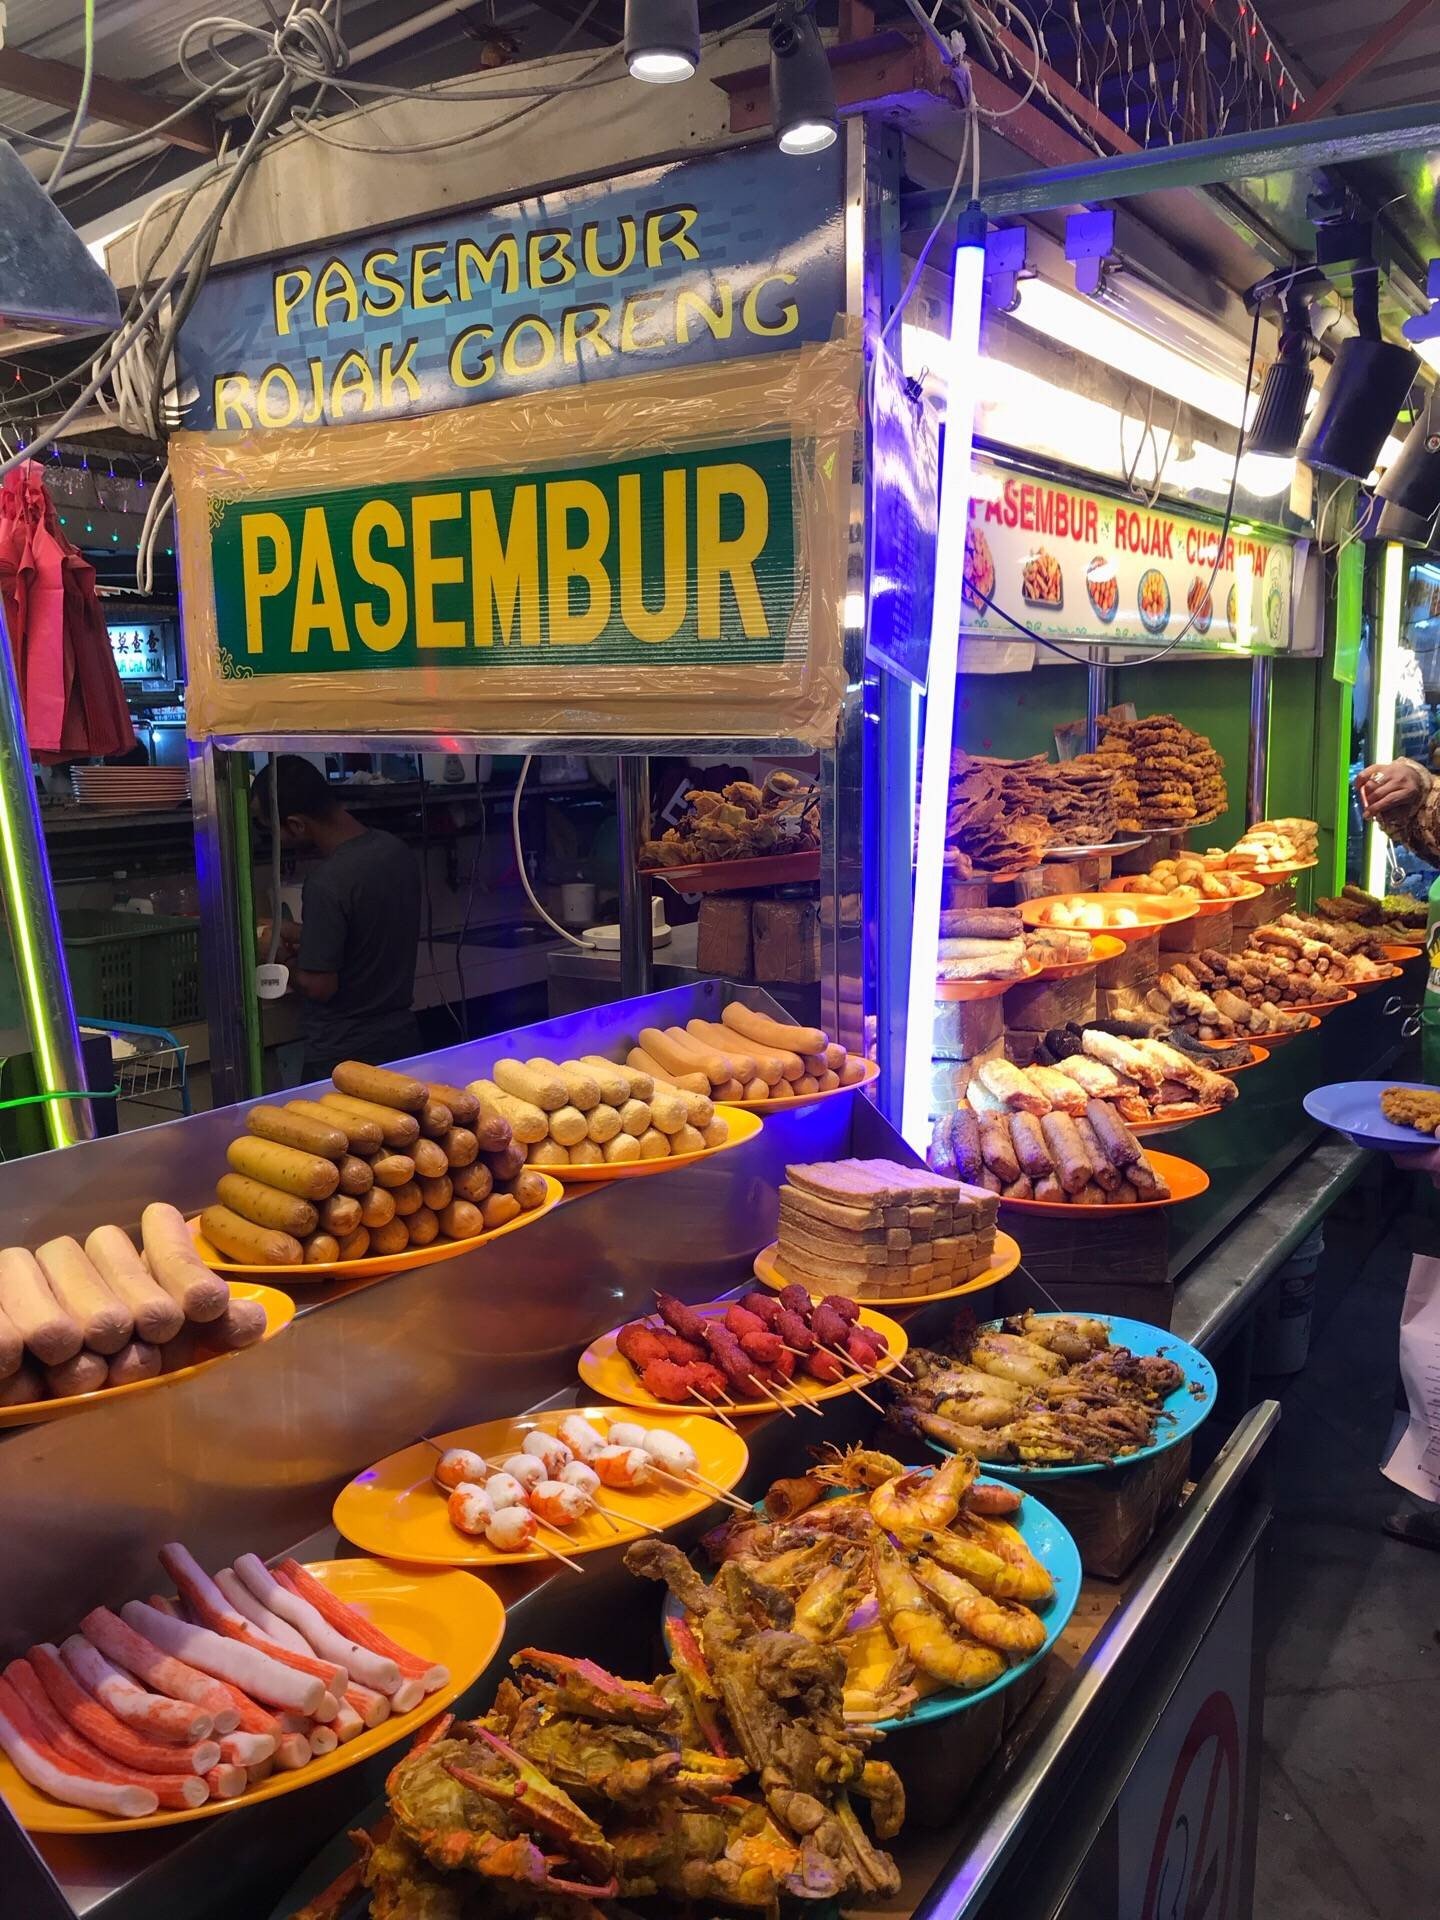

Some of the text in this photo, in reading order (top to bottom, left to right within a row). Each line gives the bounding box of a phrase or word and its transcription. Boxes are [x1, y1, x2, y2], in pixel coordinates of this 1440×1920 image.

[273, 204, 701, 337] PASEMBUR
[214, 272, 800, 430] ROJAK GORENG
[241, 461, 771, 654] PASEMBUR
[1115, 508, 1174, 560] ROJAK
